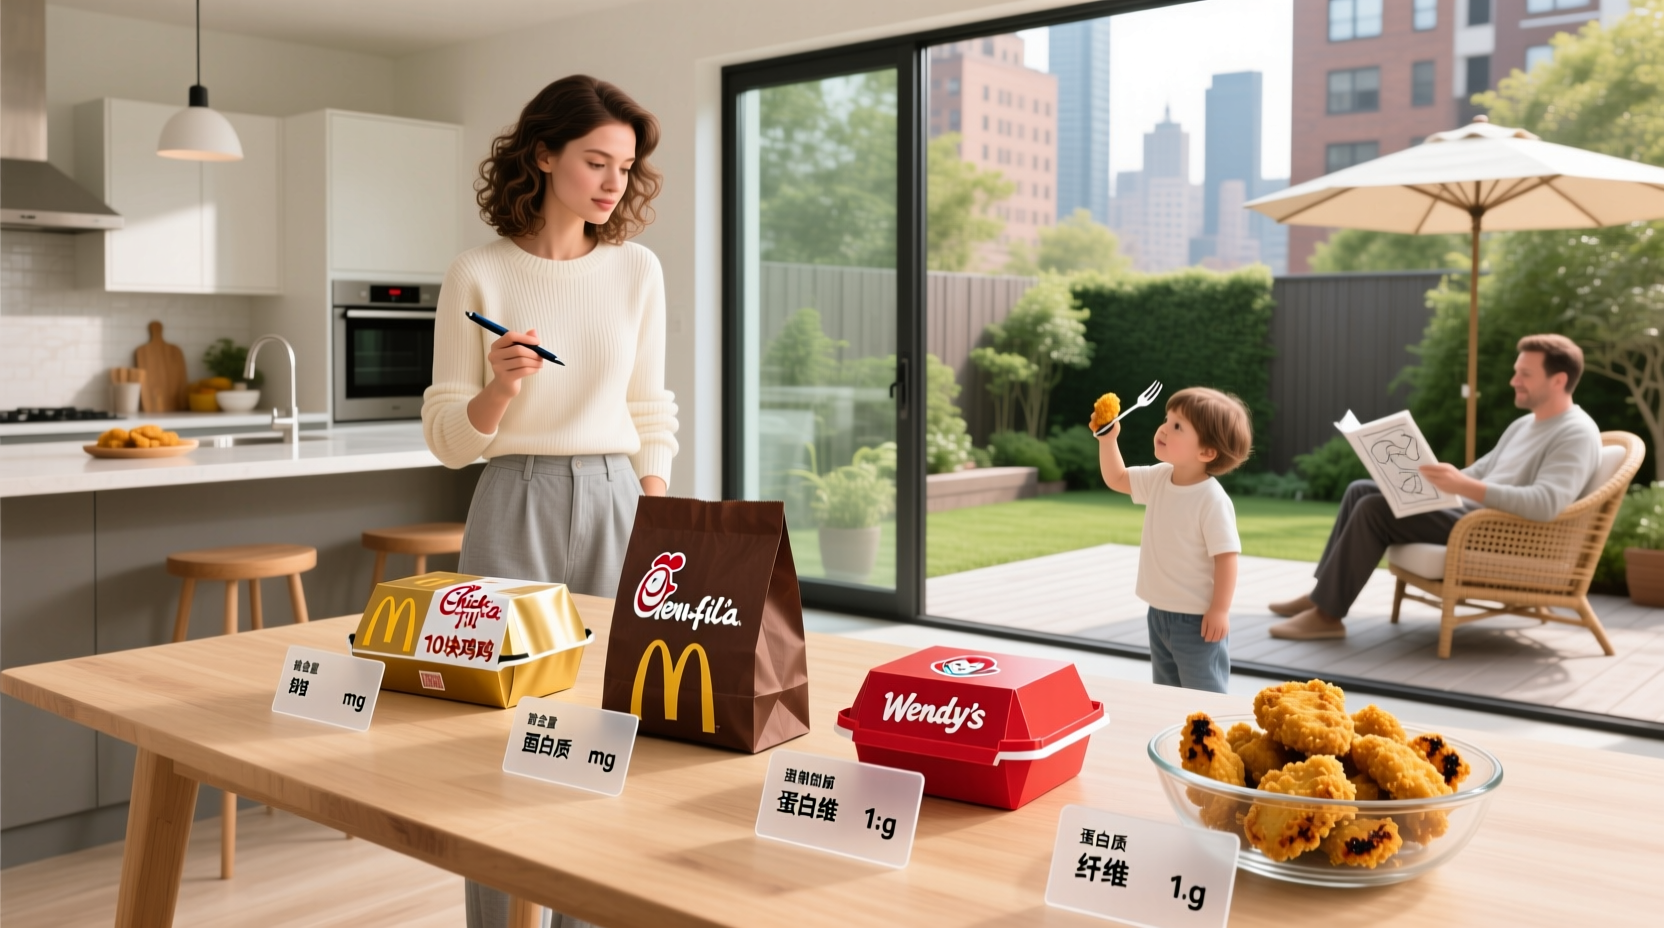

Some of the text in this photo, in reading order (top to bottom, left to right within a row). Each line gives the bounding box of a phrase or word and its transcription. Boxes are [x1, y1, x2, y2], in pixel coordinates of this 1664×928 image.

[342, 692, 366, 712] mg
[882, 691, 986, 734] Wendy's
[588, 749, 616, 773] mg
[1074, 852, 1206, 912] 纤维 1.g
